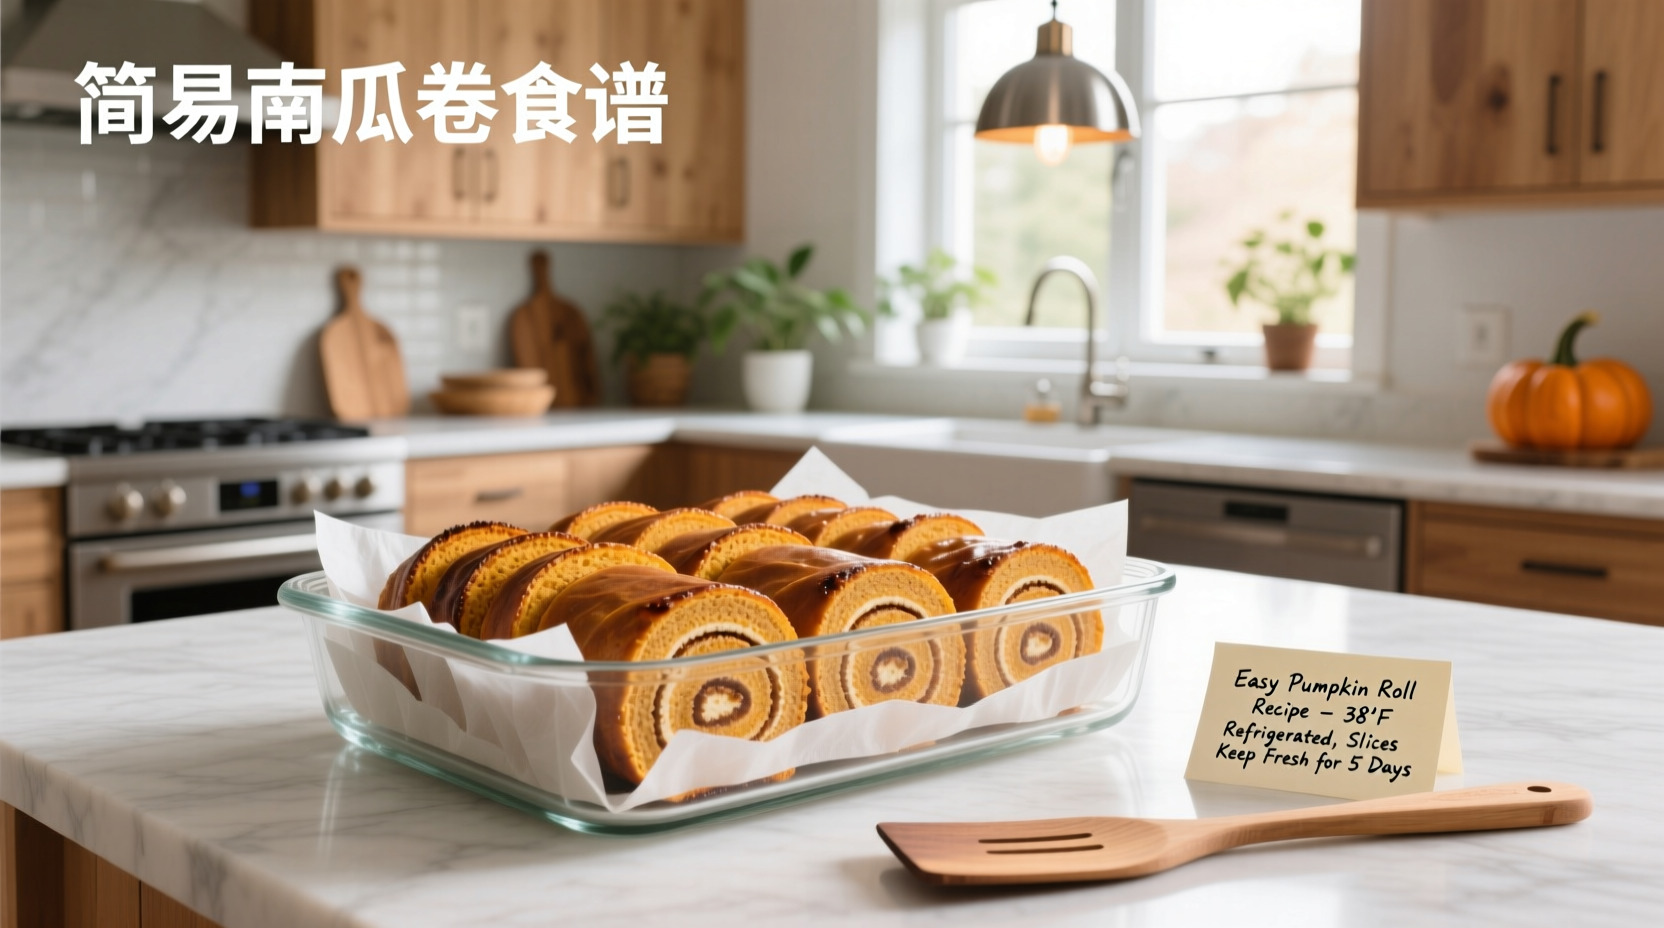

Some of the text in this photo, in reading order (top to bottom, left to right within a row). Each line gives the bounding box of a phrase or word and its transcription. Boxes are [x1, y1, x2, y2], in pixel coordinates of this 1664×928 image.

[1234, 668, 1418, 702] Easy Pumpkin Roll
[1251, 697, 1310, 724] Recipe
[1222, 720, 1399, 752] Refrigerated, Slices
[1215, 742, 1412, 784] Keep Fresh for 5 Days
